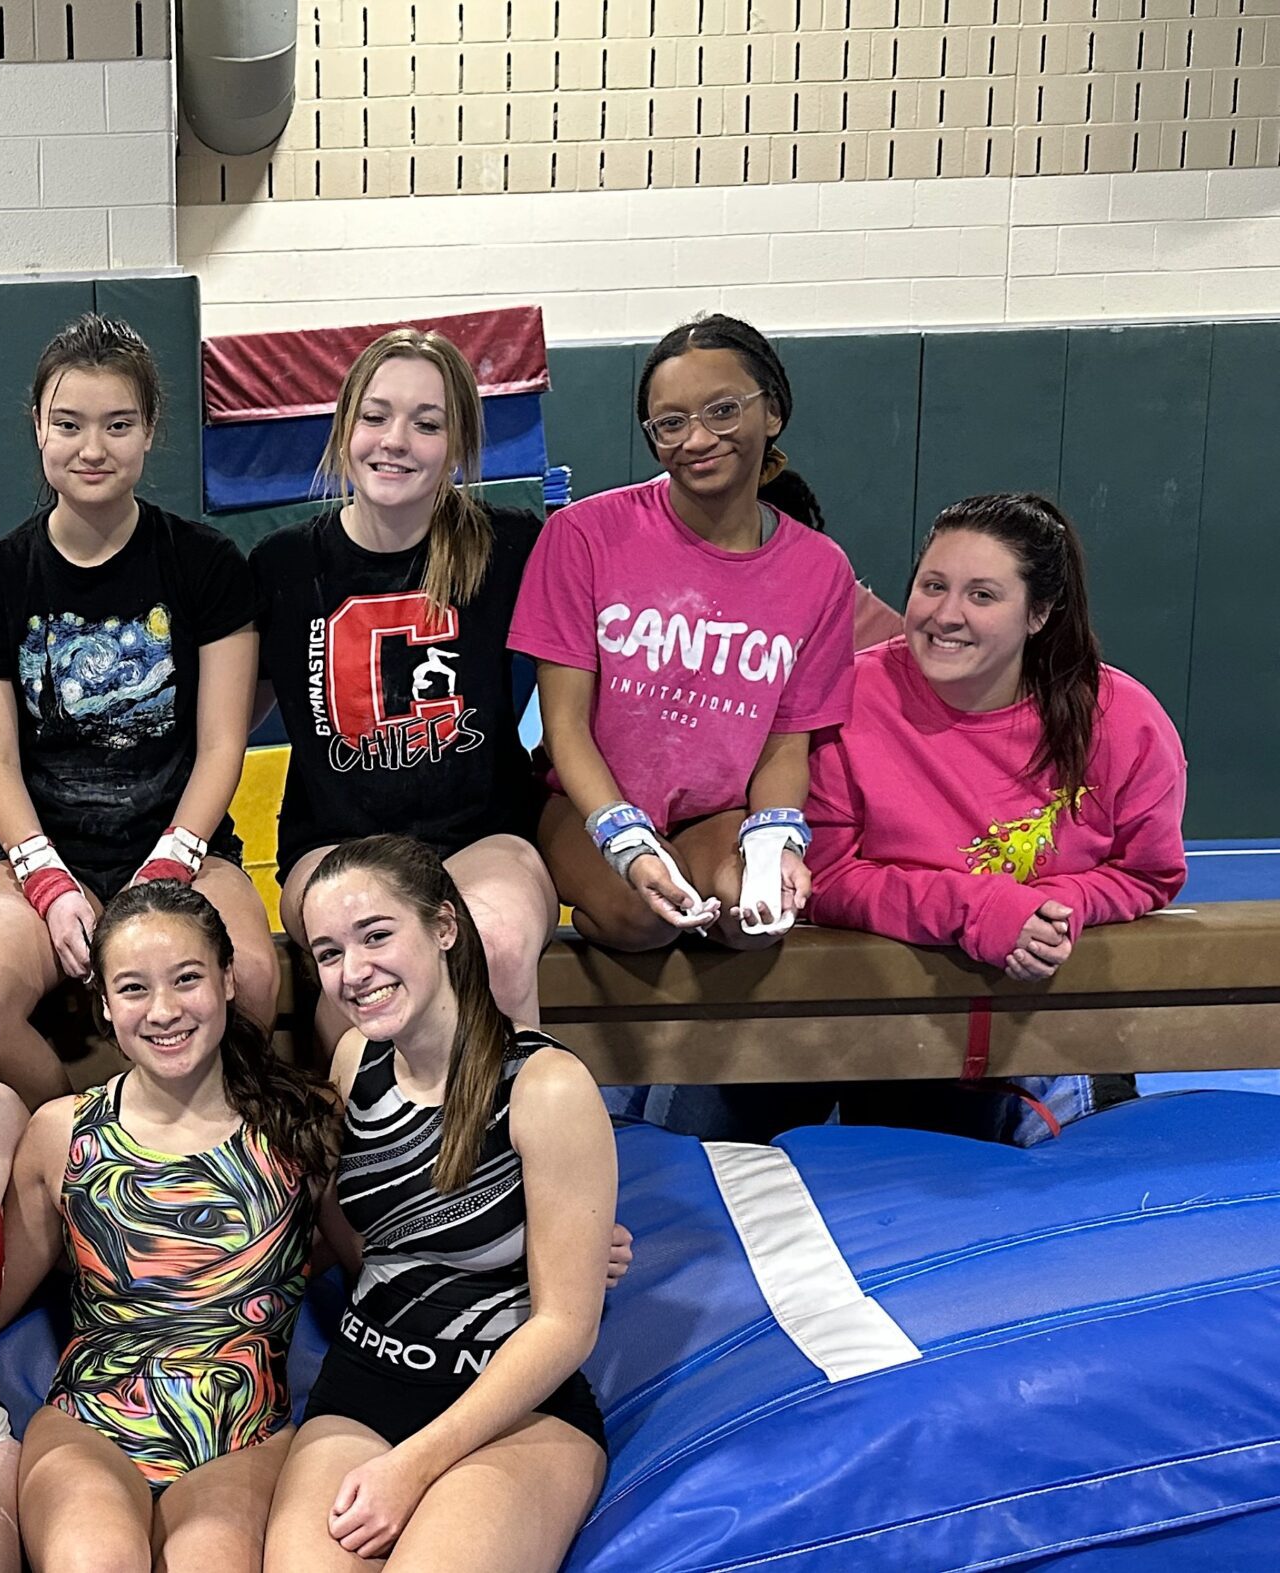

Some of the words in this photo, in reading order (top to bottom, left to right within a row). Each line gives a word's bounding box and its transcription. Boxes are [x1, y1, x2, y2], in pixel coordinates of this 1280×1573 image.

[597, 603, 804, 685] CANTON
[308, 617, 332, 737] GYMNASTICS
[609, 676, 759, 720] INVITATIONAL
[328, 708, 486, 773] CHIEFS
[660, 709, 699, 730] 2023
[360, 1326, 437, 1370] PRO
